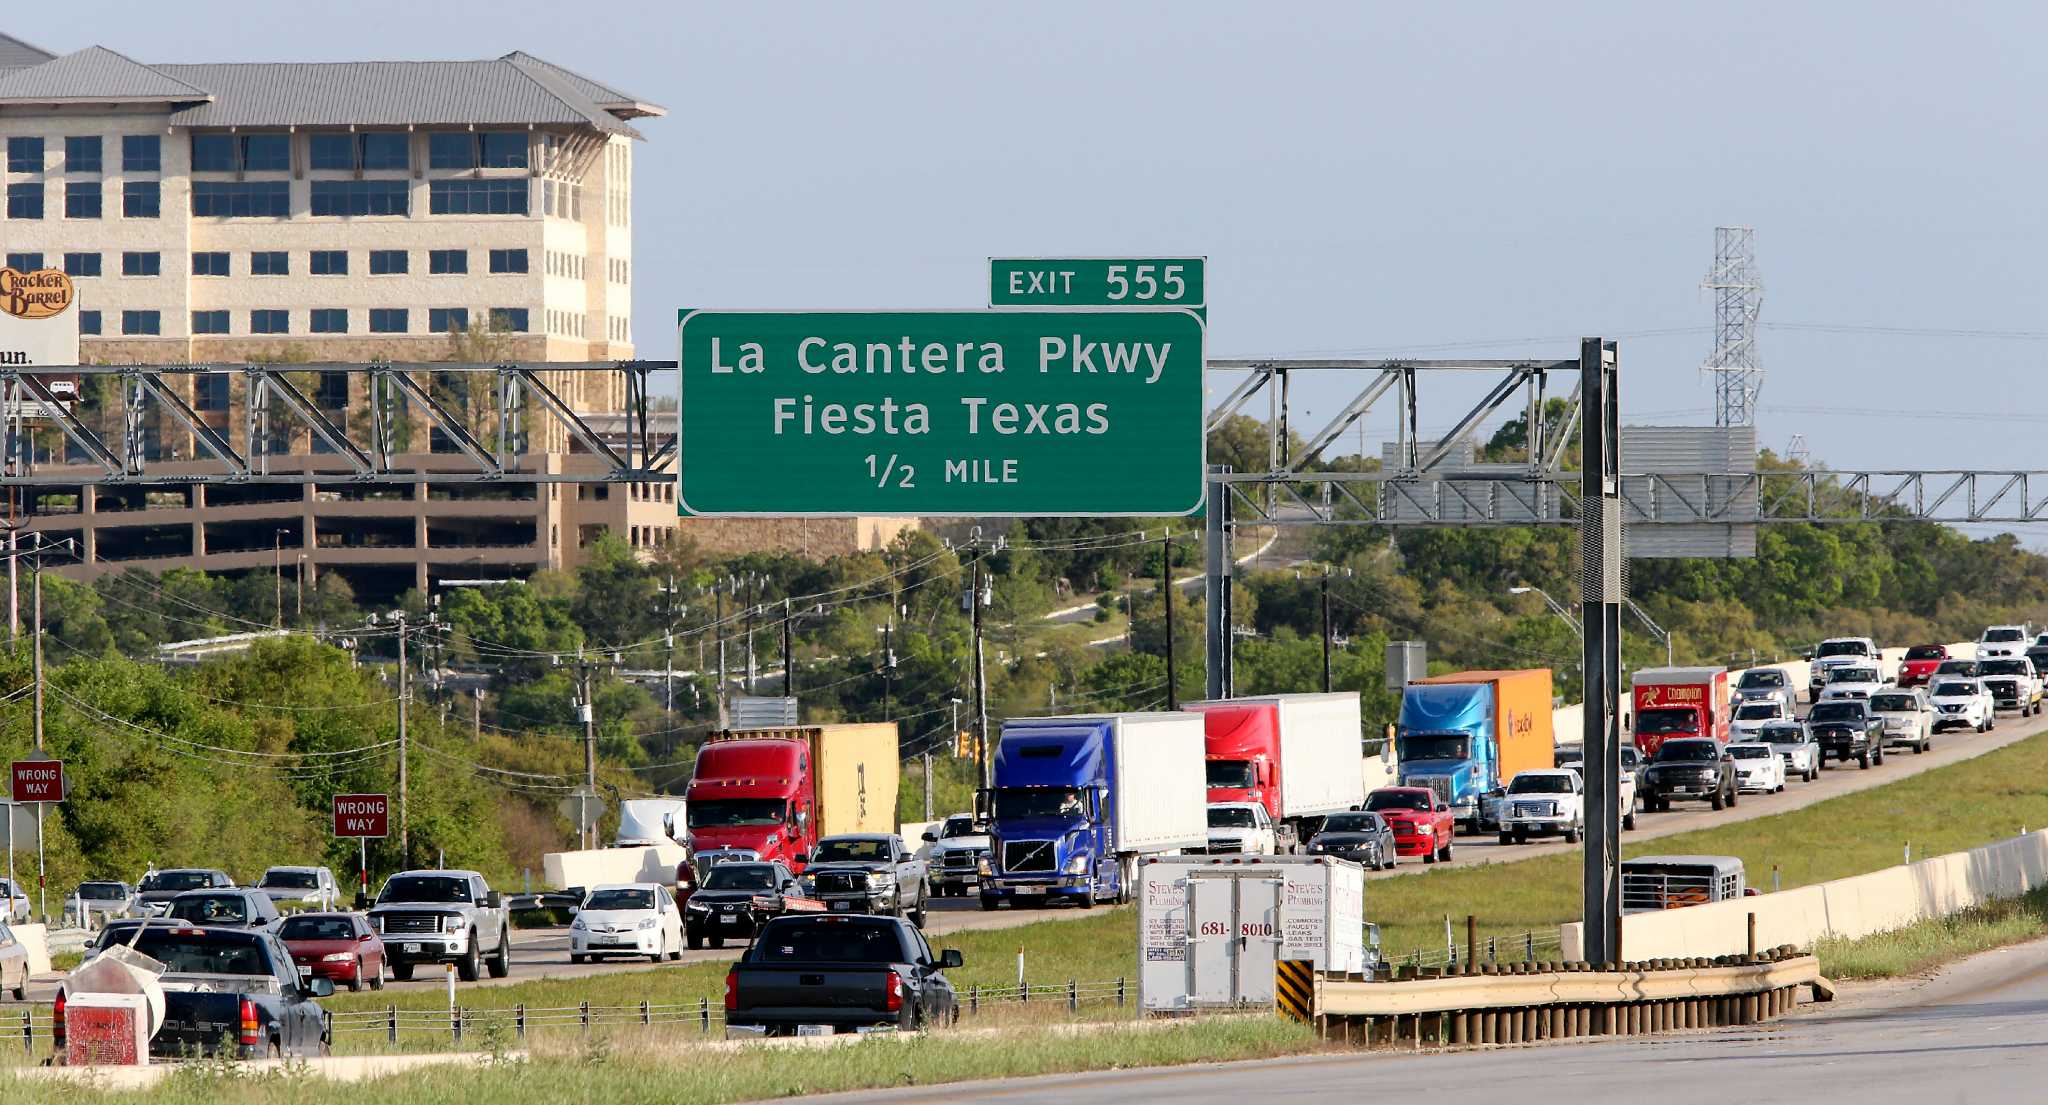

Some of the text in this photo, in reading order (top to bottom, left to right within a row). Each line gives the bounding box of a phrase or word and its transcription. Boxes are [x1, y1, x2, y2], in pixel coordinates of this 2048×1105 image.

[0, 269, 63, 296] Cracker
[1009, 265, 1185, 300] EXIT 555
[11, 288, 66, 315] Barrel
[0, 351, 32, 364] un.
[711, 334, 1172, 384] La Cantera Pkwy
[774, 395, 1109, 435] Fiesta Texas
[864, 454, 1018, 488] 1/2 MILE
[17, 769, 57, 780] WRONG
[26, 783, 49, 794] WAY
[337, 801, 385, 814] WRONG
[346, 818, 375, 831] WAY
[1241, 923, 1272, 936] 8010
[163, 1020, 230, 1033] OLET
